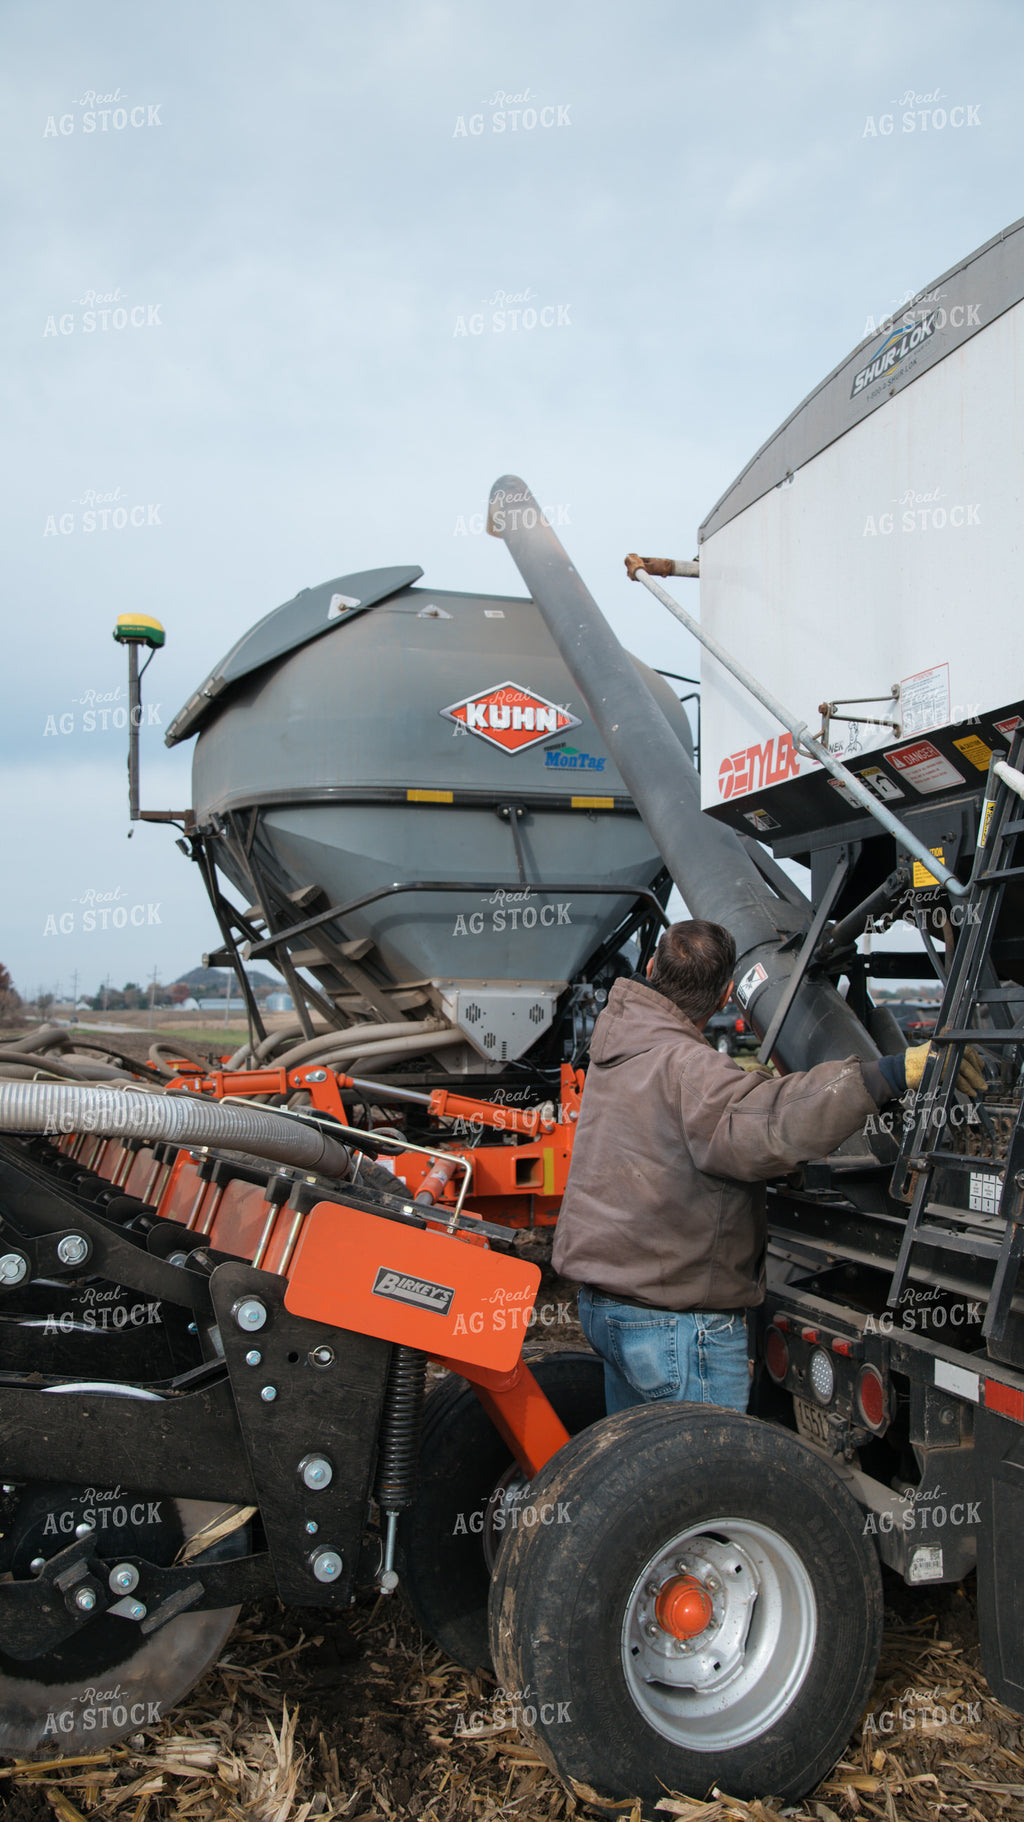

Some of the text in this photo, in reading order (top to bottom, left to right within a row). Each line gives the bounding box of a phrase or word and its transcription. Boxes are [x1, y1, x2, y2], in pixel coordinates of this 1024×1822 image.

[466, 703, 557, 732] KUHN
[544, 752, 607, 772] MonTag
[903, 746, 939, 765] DANGER
[375, 1272, 452, 1302] BIRKEY'S
